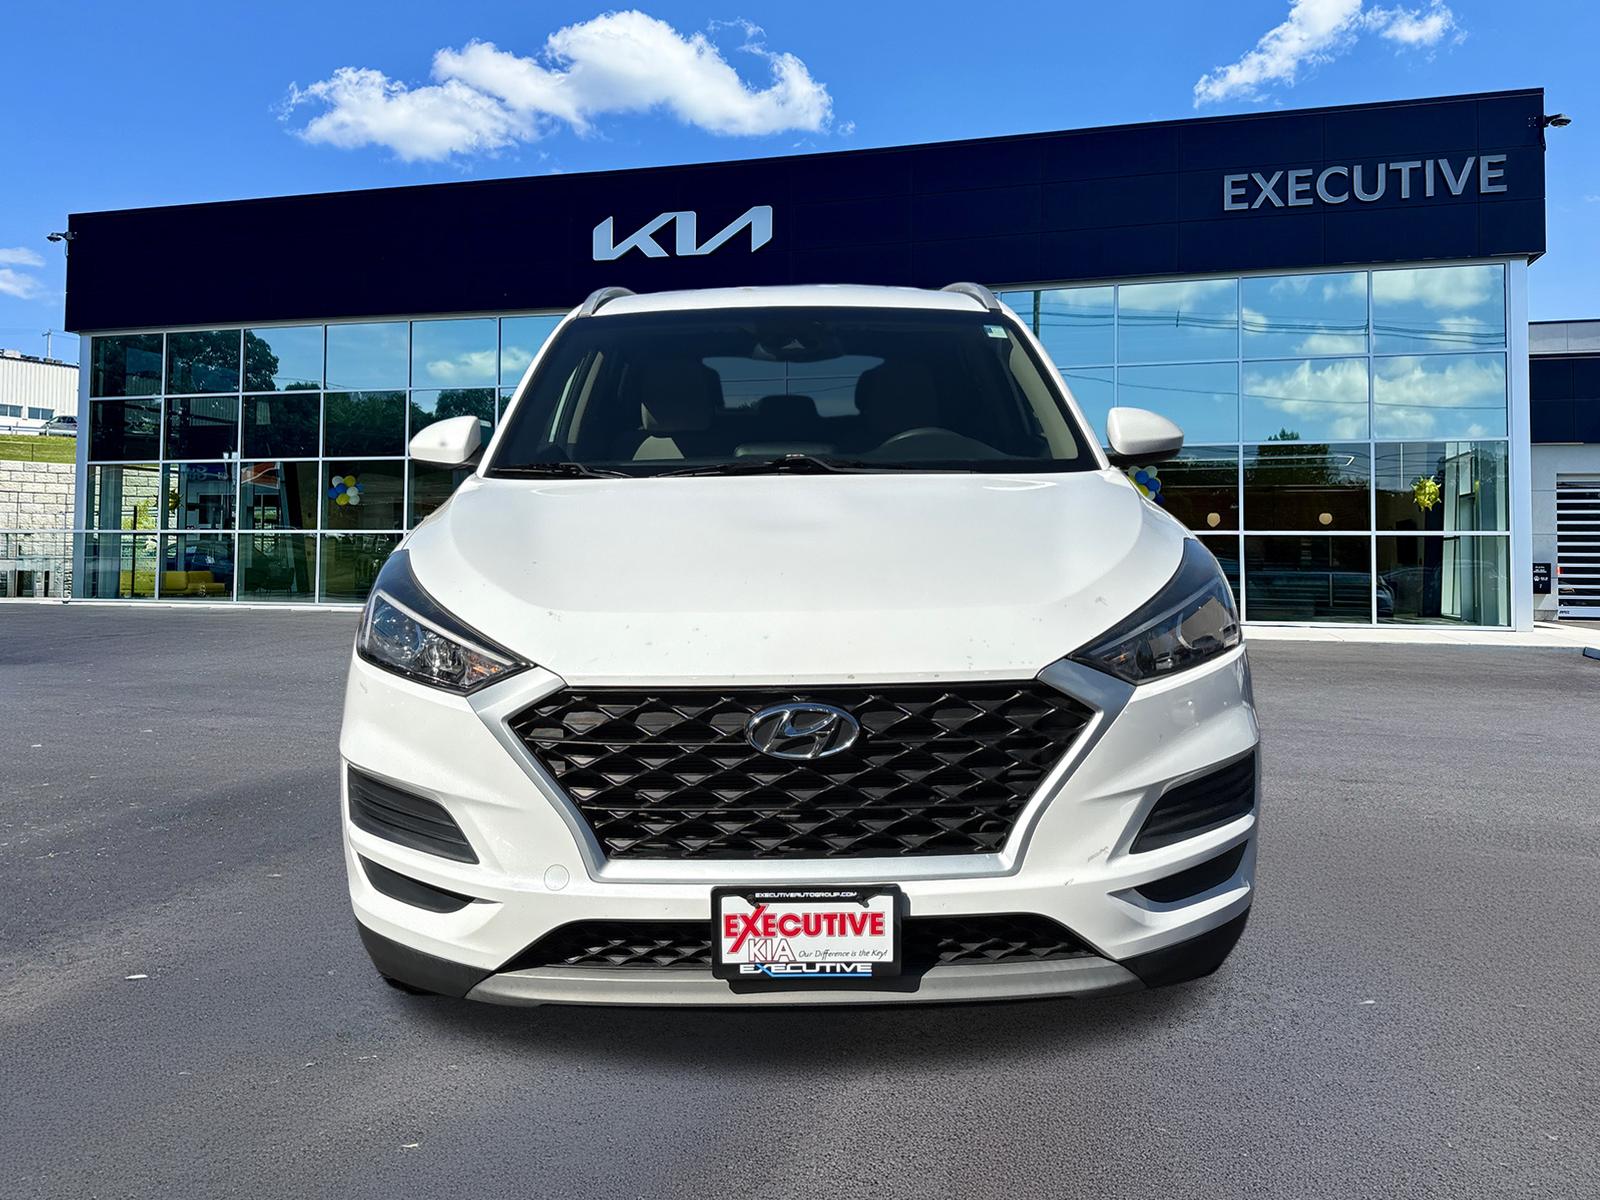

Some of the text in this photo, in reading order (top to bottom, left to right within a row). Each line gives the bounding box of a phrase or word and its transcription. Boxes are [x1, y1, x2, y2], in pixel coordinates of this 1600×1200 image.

[1223, 154, 1508, 211] EXECUTIVE
[592, 205, 773, 261] KIA
[723, 904, 886, 954] EXECUTIVE
[739, 963, 872, 974] EXECUTIVE
[748, 938, 797, 963] KIA
[798, 950, 813, 958] Our
[814, 949, 850, 961] Difference
[859, 949, 870, 957] the
[871, 948, 889, 960] Key!
